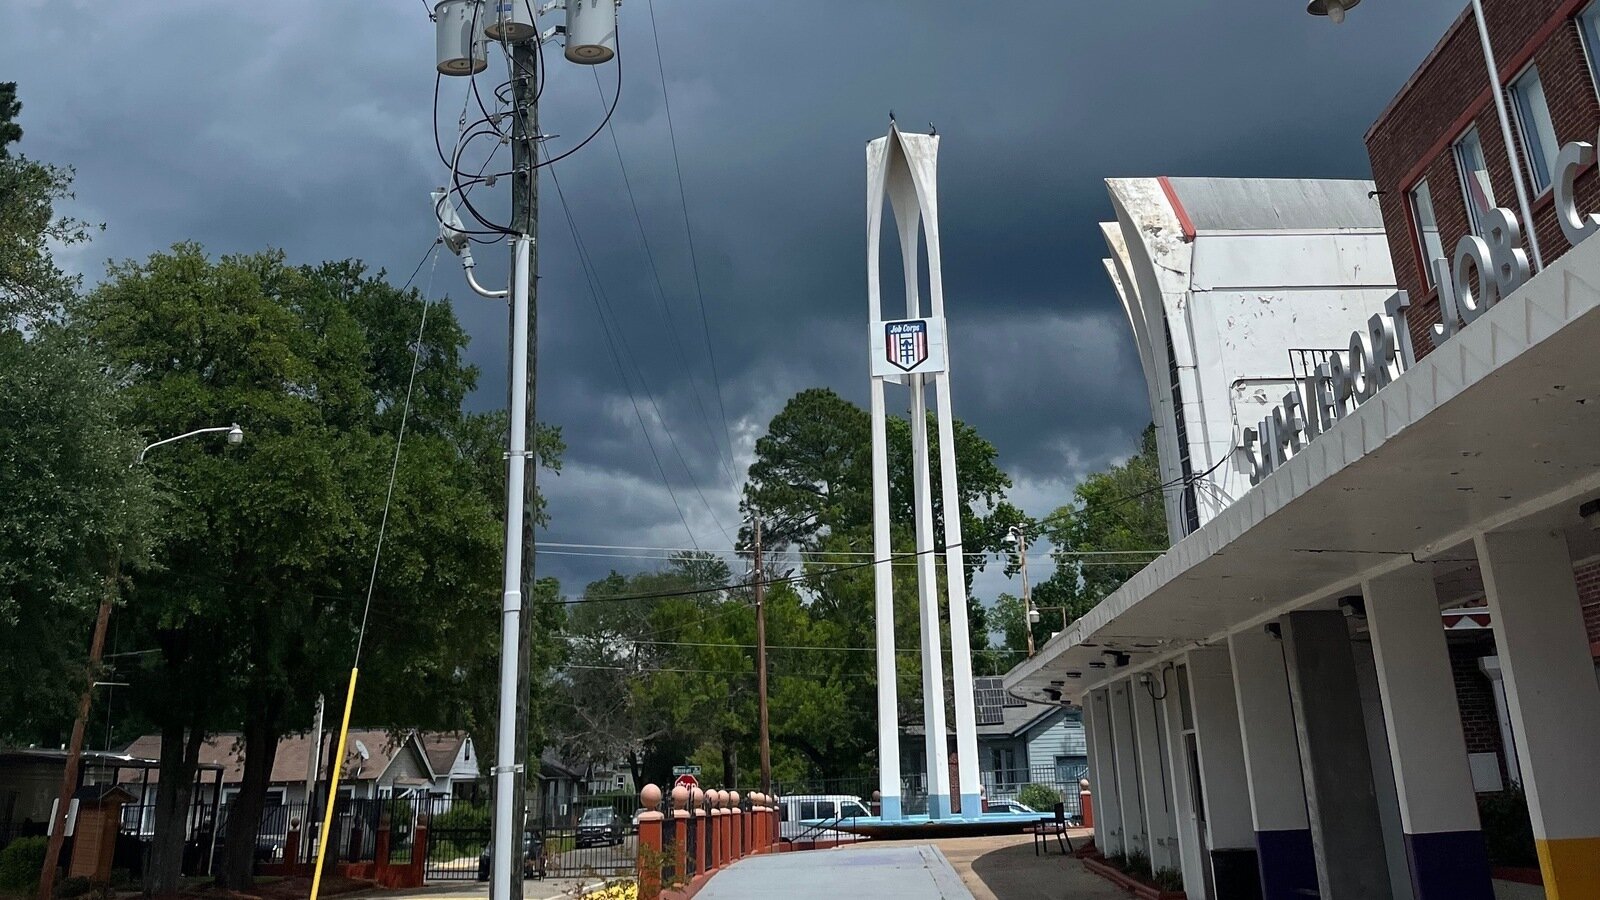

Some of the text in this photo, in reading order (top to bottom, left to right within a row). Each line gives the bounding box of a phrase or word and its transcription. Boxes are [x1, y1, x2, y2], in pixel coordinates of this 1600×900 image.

[891, 324, 919, 333] Job Corps
[1243, 140, 1600, 486] SHREVEPORT JOB C
